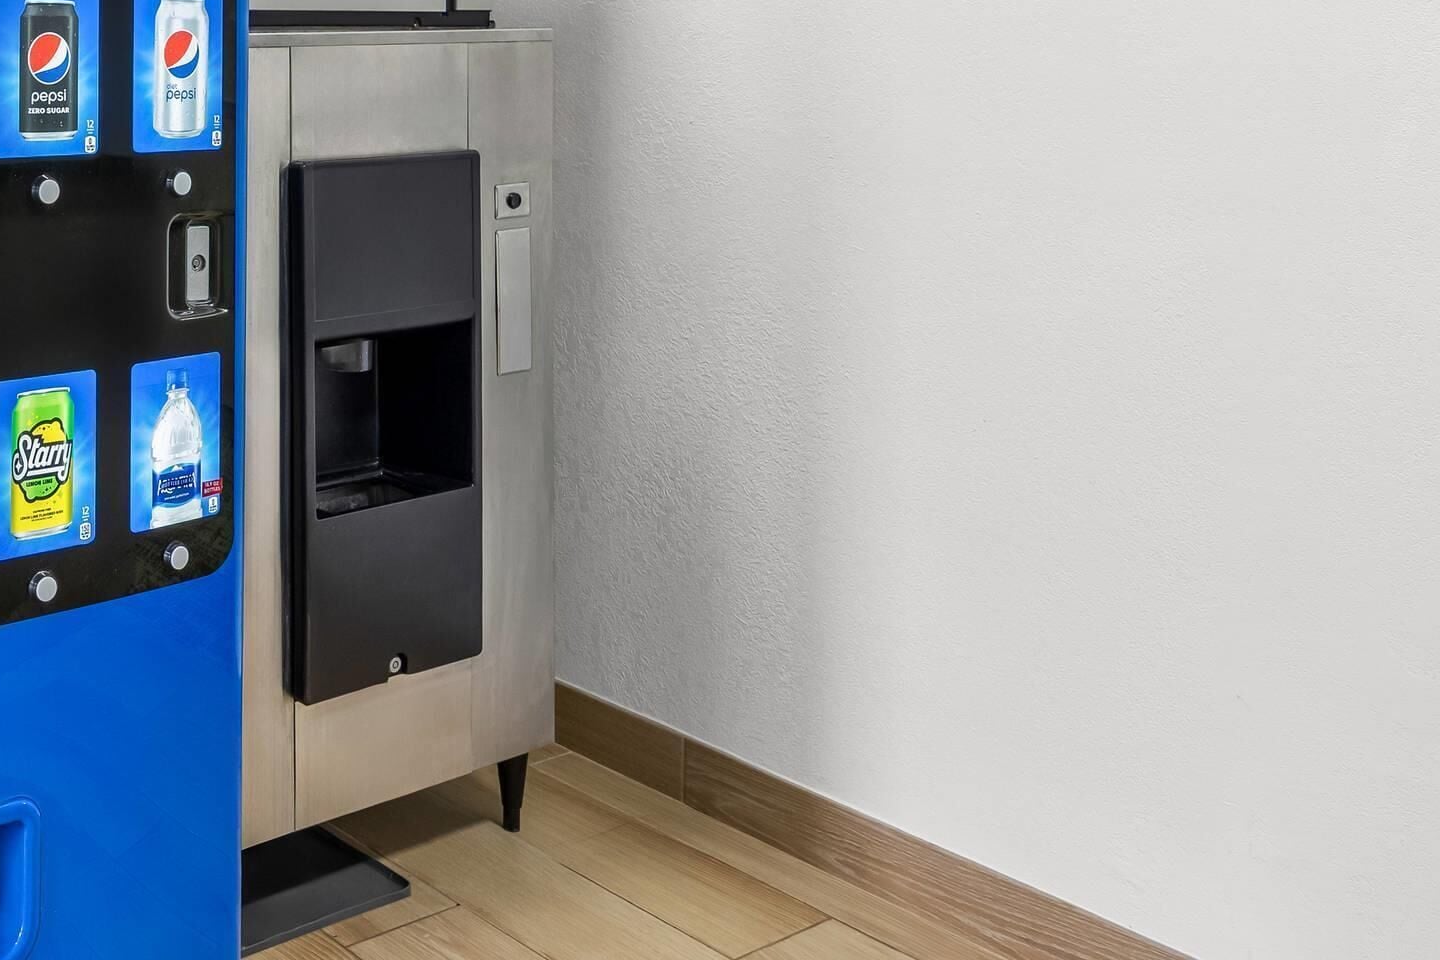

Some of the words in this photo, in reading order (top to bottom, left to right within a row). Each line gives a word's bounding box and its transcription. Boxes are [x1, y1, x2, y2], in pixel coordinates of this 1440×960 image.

[31, 89, 67, 105] pepsi
[166, 87, 197, 103] pepsi
[27, 106, 46, 115] ZERO
[46, 106, 70, 115] SUGAR
[86, 119, 95, 129] 12
[13, 434, 72, 482] Starry
